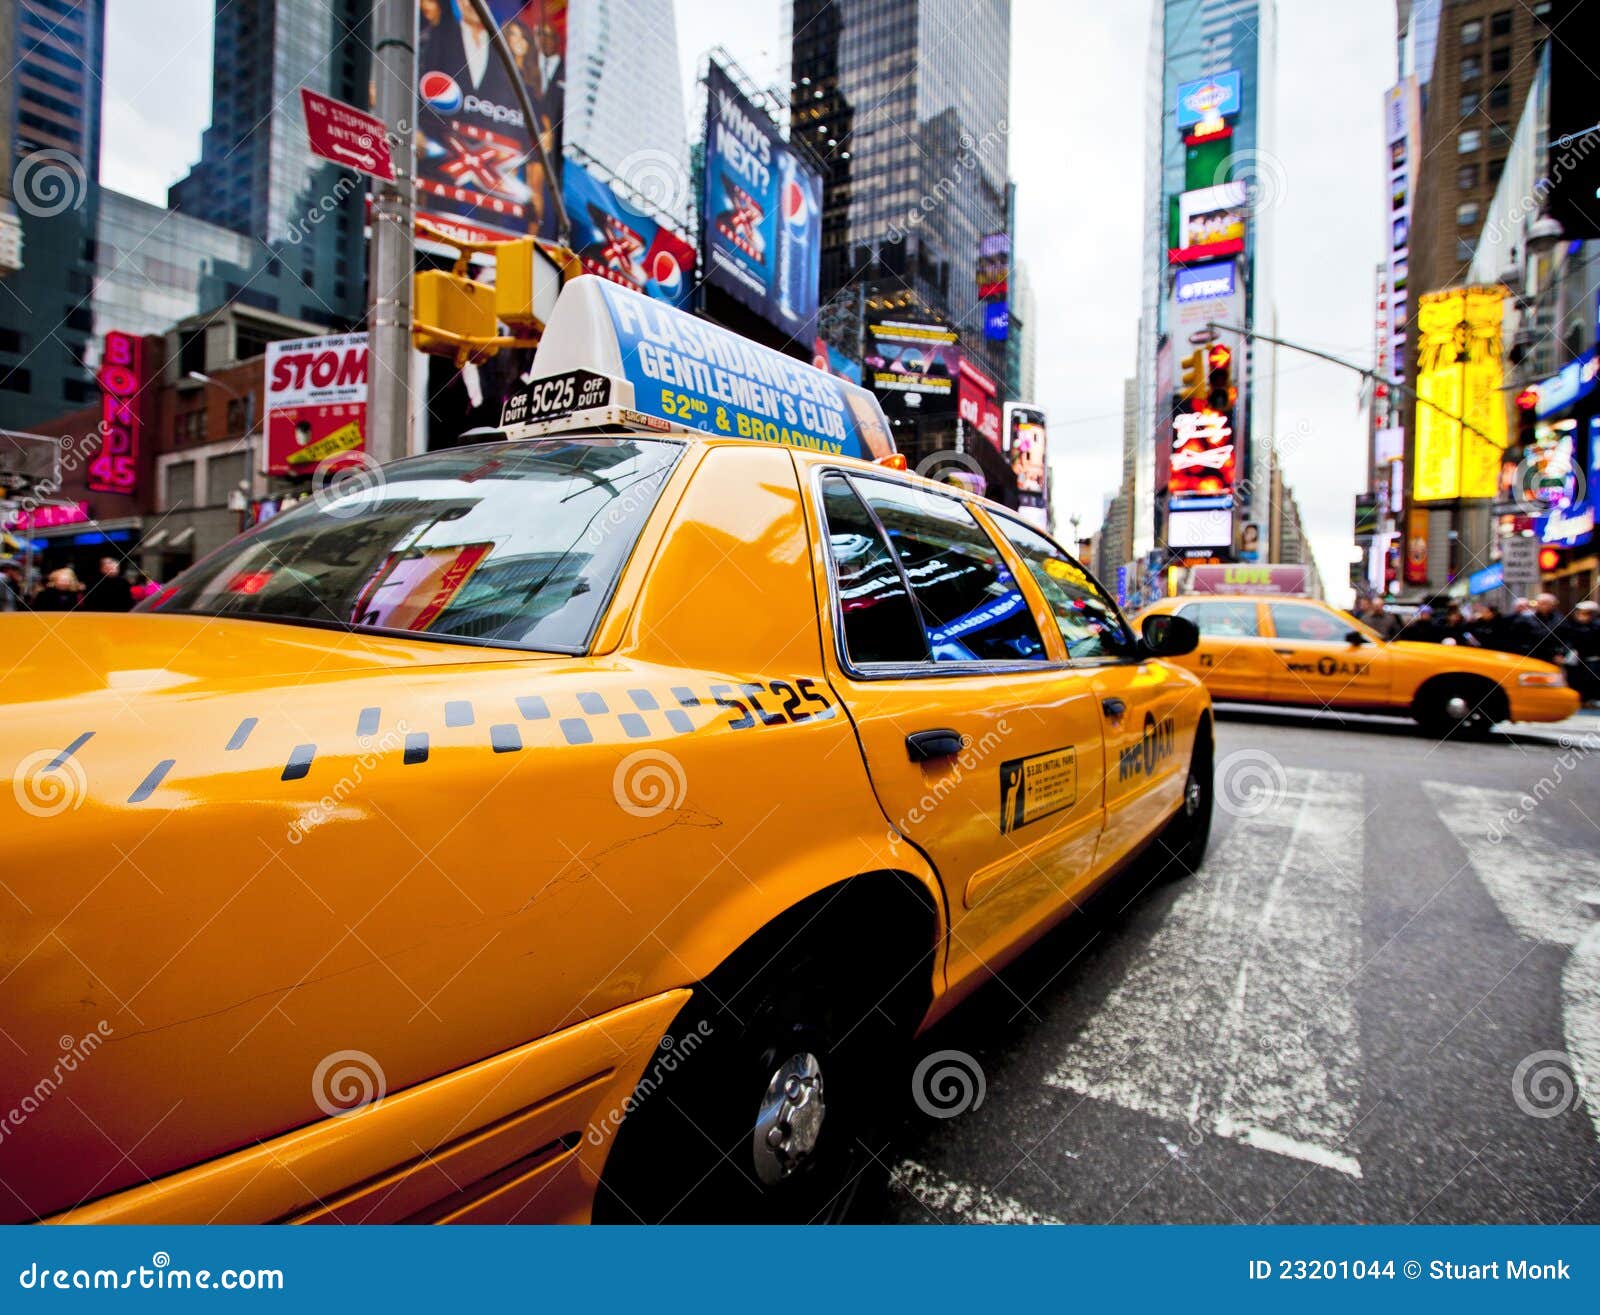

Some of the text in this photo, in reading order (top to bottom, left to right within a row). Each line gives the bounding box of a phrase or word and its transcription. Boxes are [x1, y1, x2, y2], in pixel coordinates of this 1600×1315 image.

[611, 291, 846, 413] FLASHDANCERS
[511, 393, 528, 409] OFF
[530, 376, 576, 415] 5C25
[577, 390, 606, 408] DUTY
[582, 377, 604, 394] OFF
[637, 340, 847, 441] GENTLEMEN'S CLUB
[504, 406, 528, 423] DUTY
[661, 388, 708, 420] 52ND
[715, 406, 732, 432] &
[708, 678, 836, 730] 5C25
